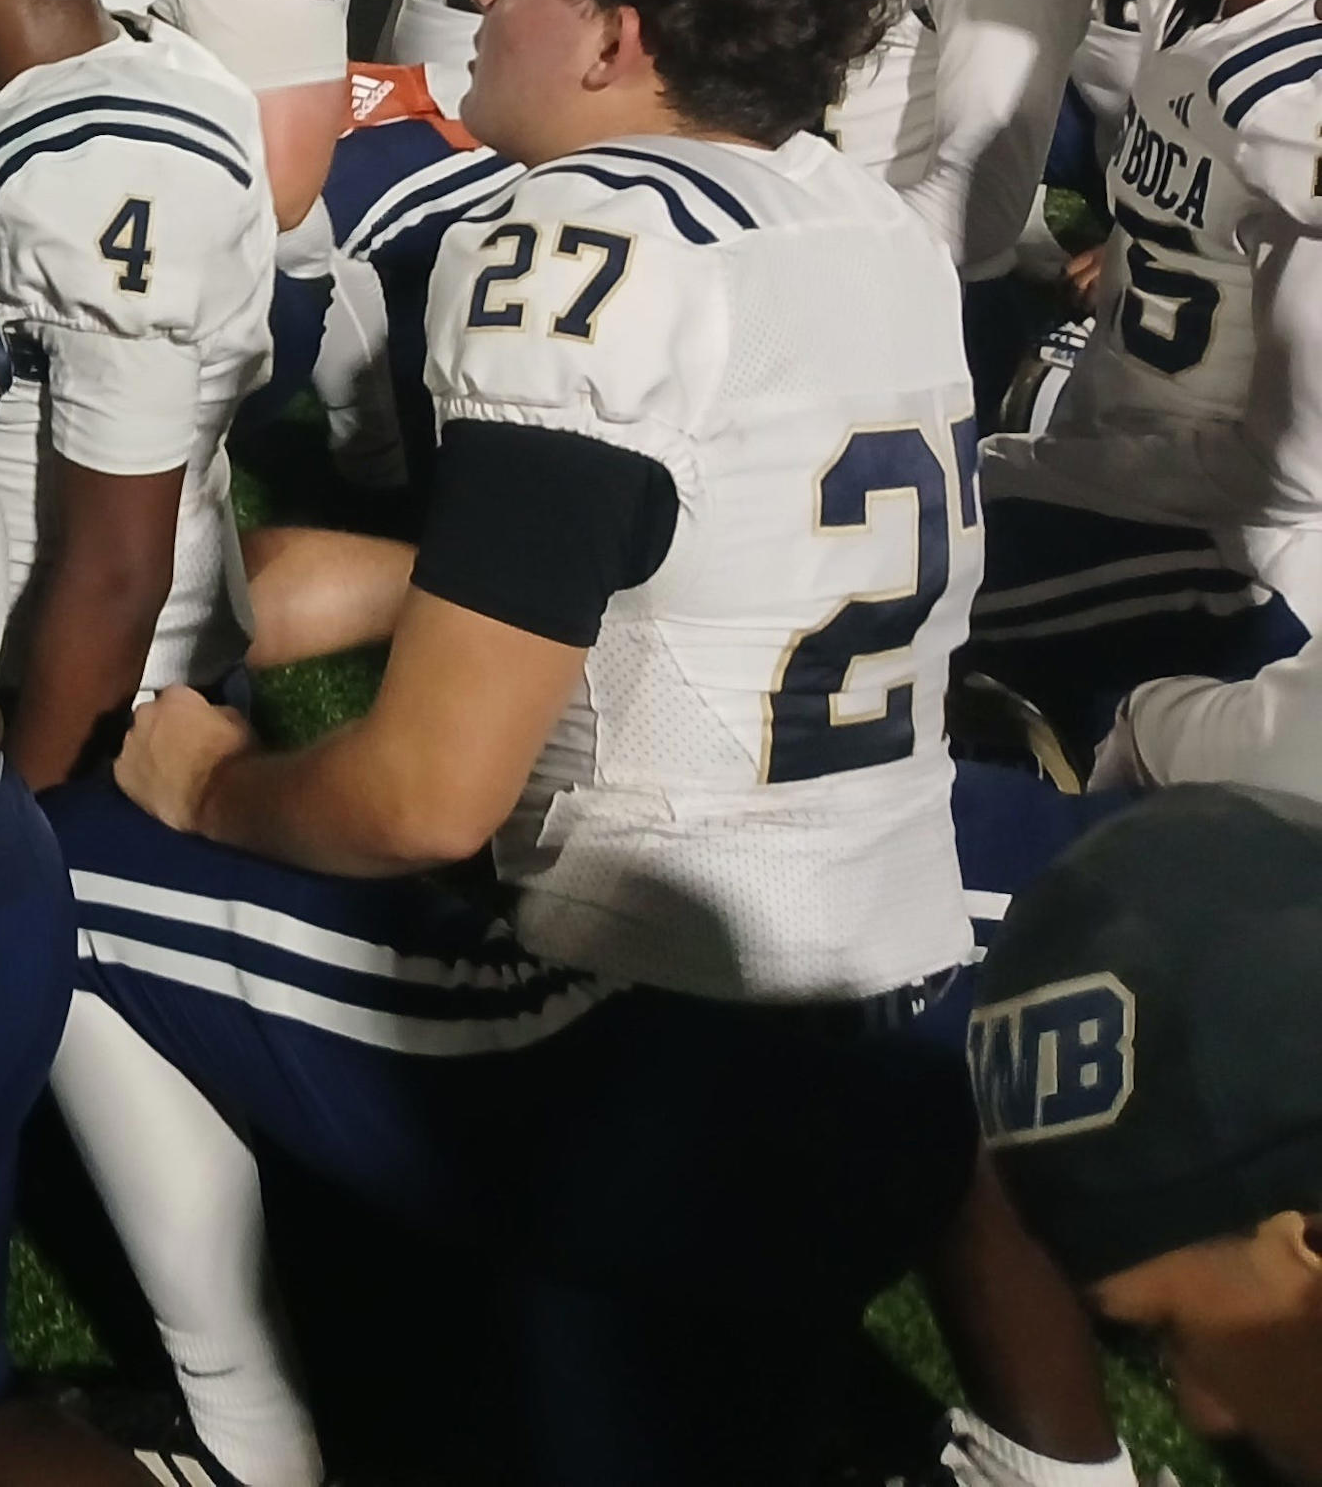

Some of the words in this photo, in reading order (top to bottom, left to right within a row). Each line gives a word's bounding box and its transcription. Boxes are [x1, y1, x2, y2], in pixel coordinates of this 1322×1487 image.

[1120, 115, 1212, 230] BOCA
[99, 196, 154, 295] 4
[464, 221, 636, 343] 27
[969, 981, 1131, 1139] WB
